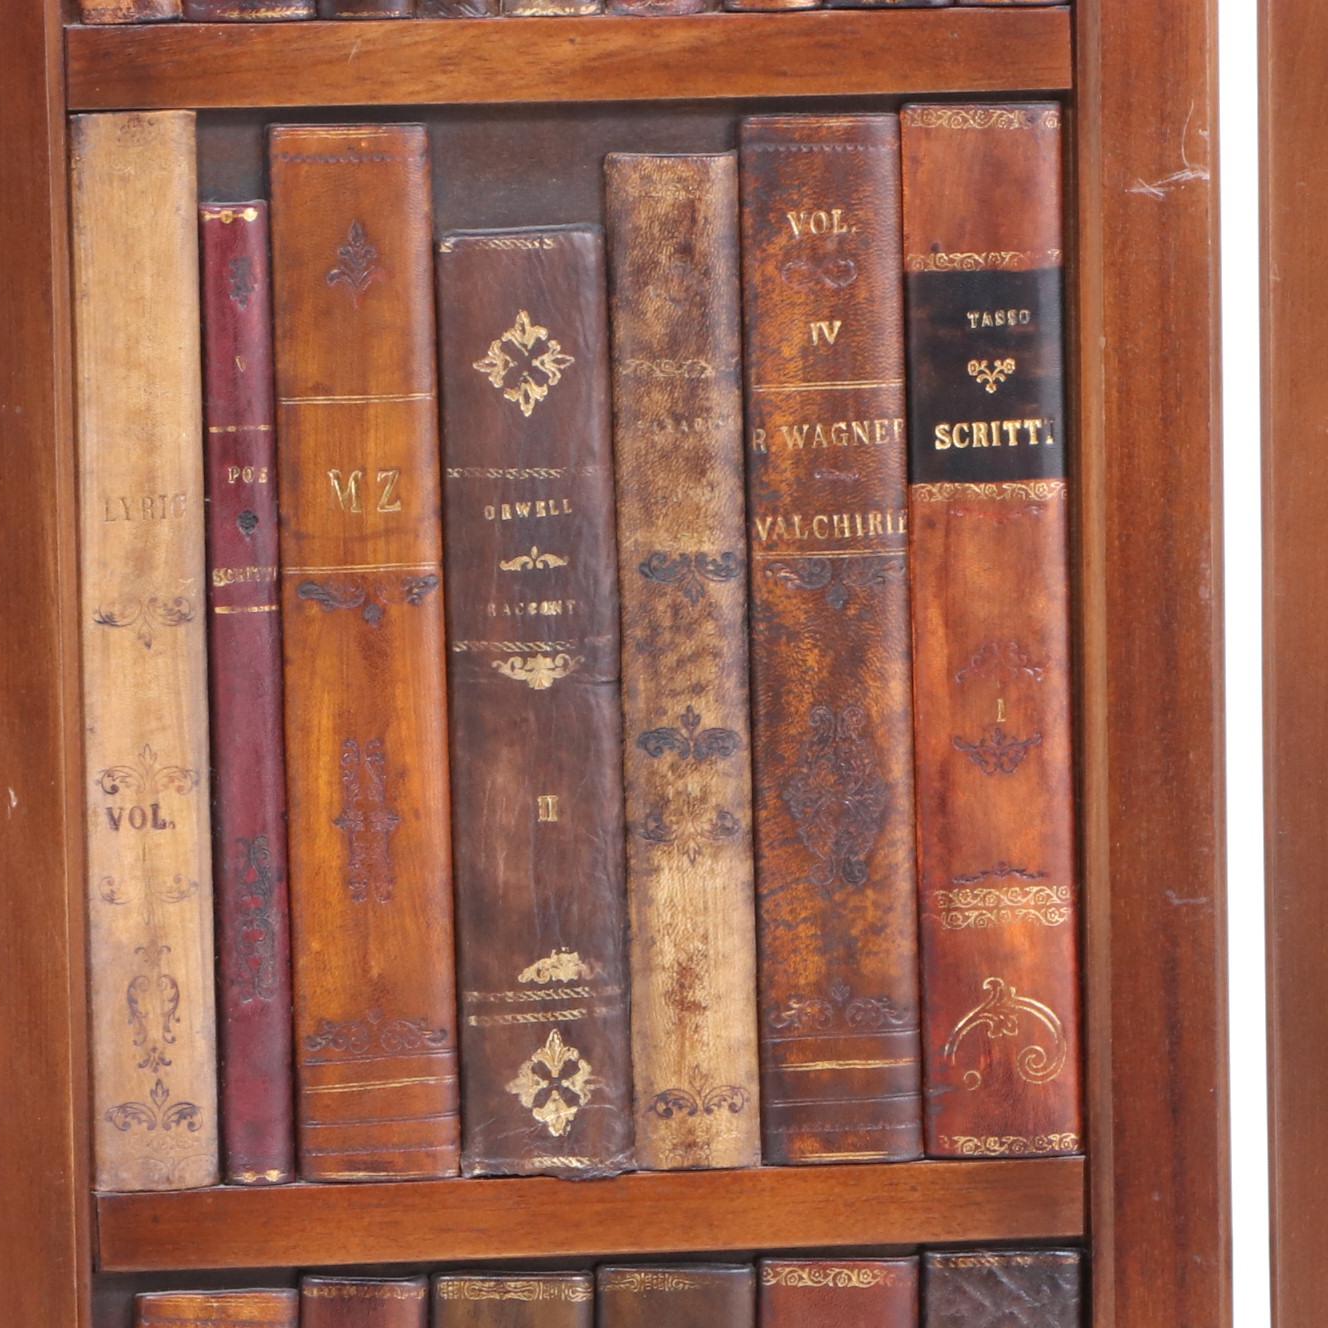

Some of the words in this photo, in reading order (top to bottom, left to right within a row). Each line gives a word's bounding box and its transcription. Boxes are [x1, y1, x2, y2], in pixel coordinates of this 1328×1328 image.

[786, 208, 858, 240] VOL.
[966, 307, 1031, 330] TASSO
[809, 320, 842, 347] IV
[934, 416, 1056, 450] SCRITTI
[484, 498, 573, 521] ORWELL
[105, 801, 177, 832] VOL.
